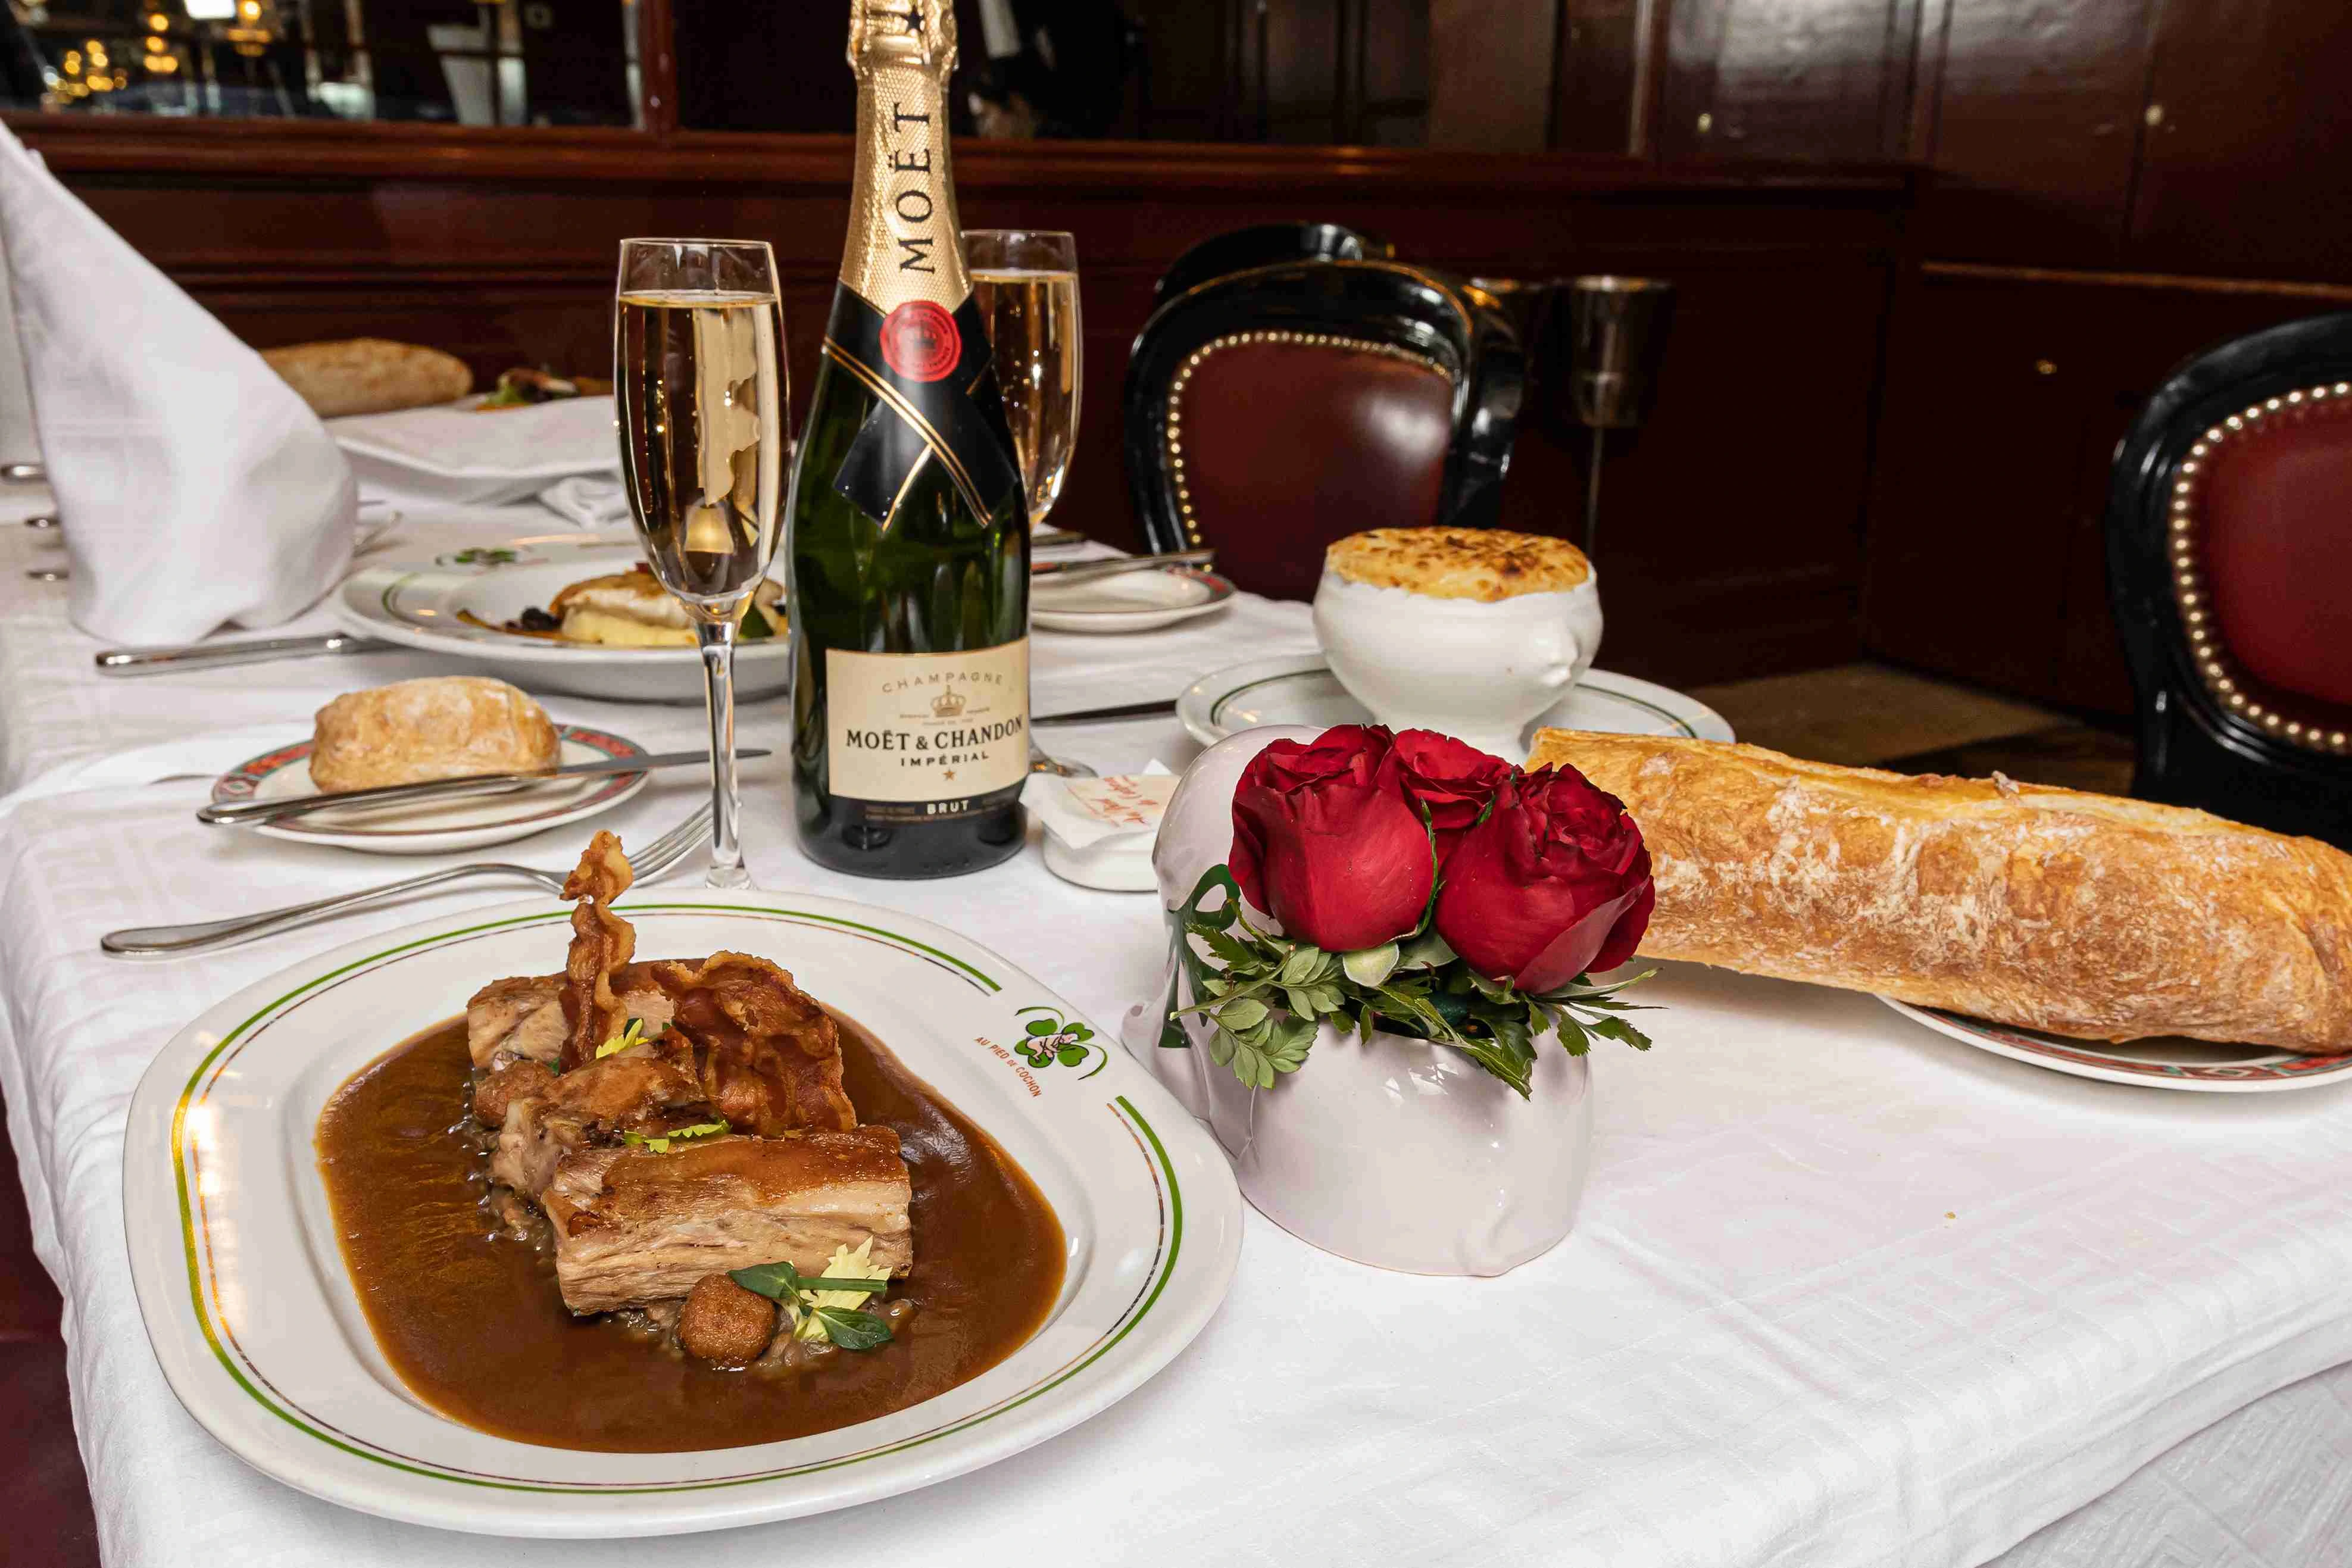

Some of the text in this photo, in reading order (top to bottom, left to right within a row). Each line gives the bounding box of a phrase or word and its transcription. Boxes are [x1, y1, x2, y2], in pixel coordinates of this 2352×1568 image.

[888, 102, 935, 274] MOËT
[882, 671, 1004, 694] CHAMPAGNE
[845, 715, 1024, 751] MOËT & CHANDON
[900, 751, 990, 767] IMPÉRIAL
[926, 799, 970, 815] BRUT
[974, 1037, 991, 1045] AU
[990, 1044, 1010, 1058] PIED
[1016, 1067, 1042, 1097] COCHON
